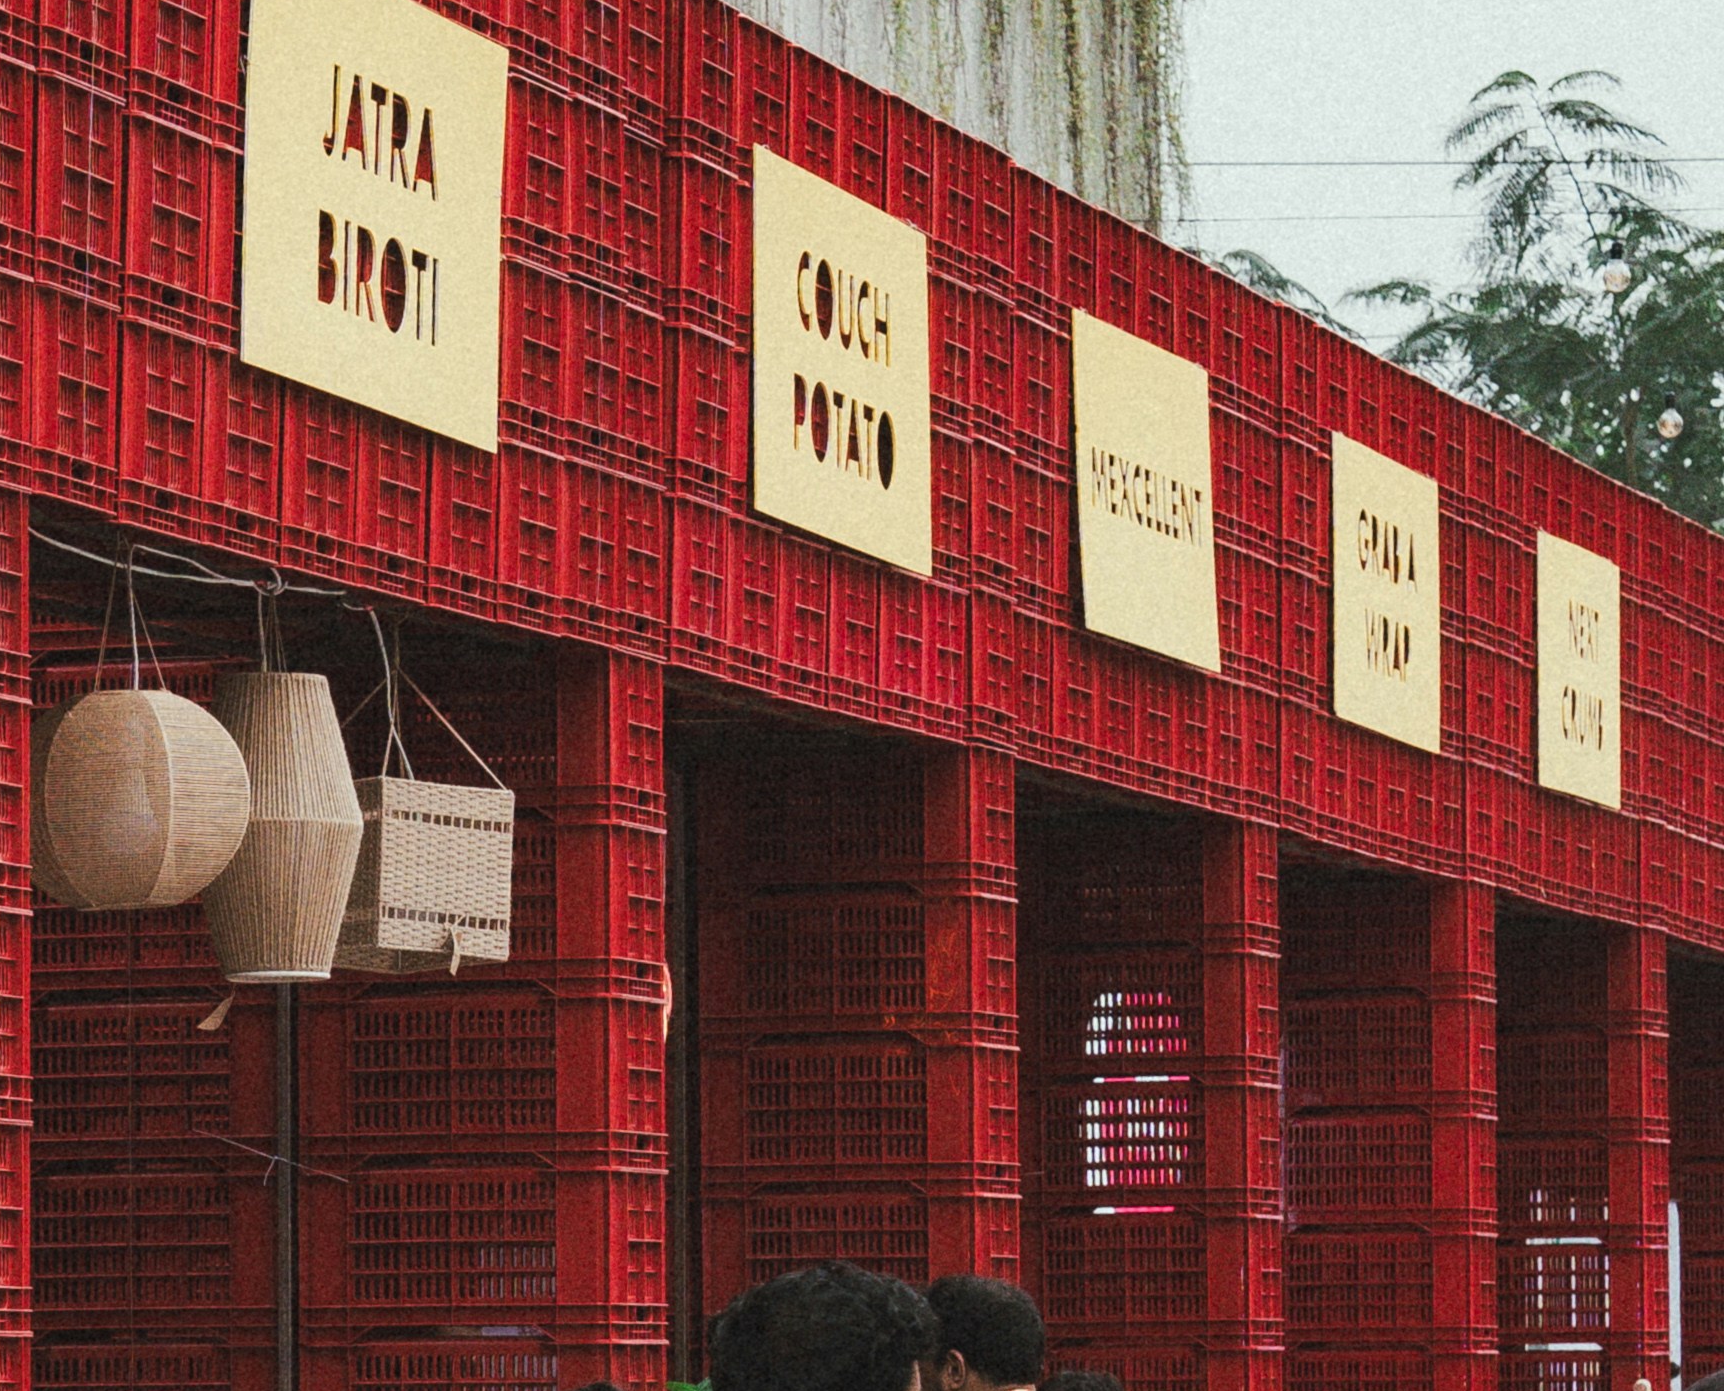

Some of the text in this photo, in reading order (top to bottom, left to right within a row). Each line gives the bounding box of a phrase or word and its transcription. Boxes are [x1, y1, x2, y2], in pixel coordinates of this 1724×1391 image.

[322, 63, 439, 202] JATRA
[317, 208, 440, 347] BIROTI
[796, 250, 891, 368] COUCH
[793, 372, 898, 491] POTATO
[1091, 445, 1203, 549] MEXCELLENT
[1357, 507, 1419, 595] GRAB A
[1364, 607, 1411, 683] WRAP
[1568, 598, 1600, 666] NEXT
[1561, 684, 1604, 753] CRUMB
